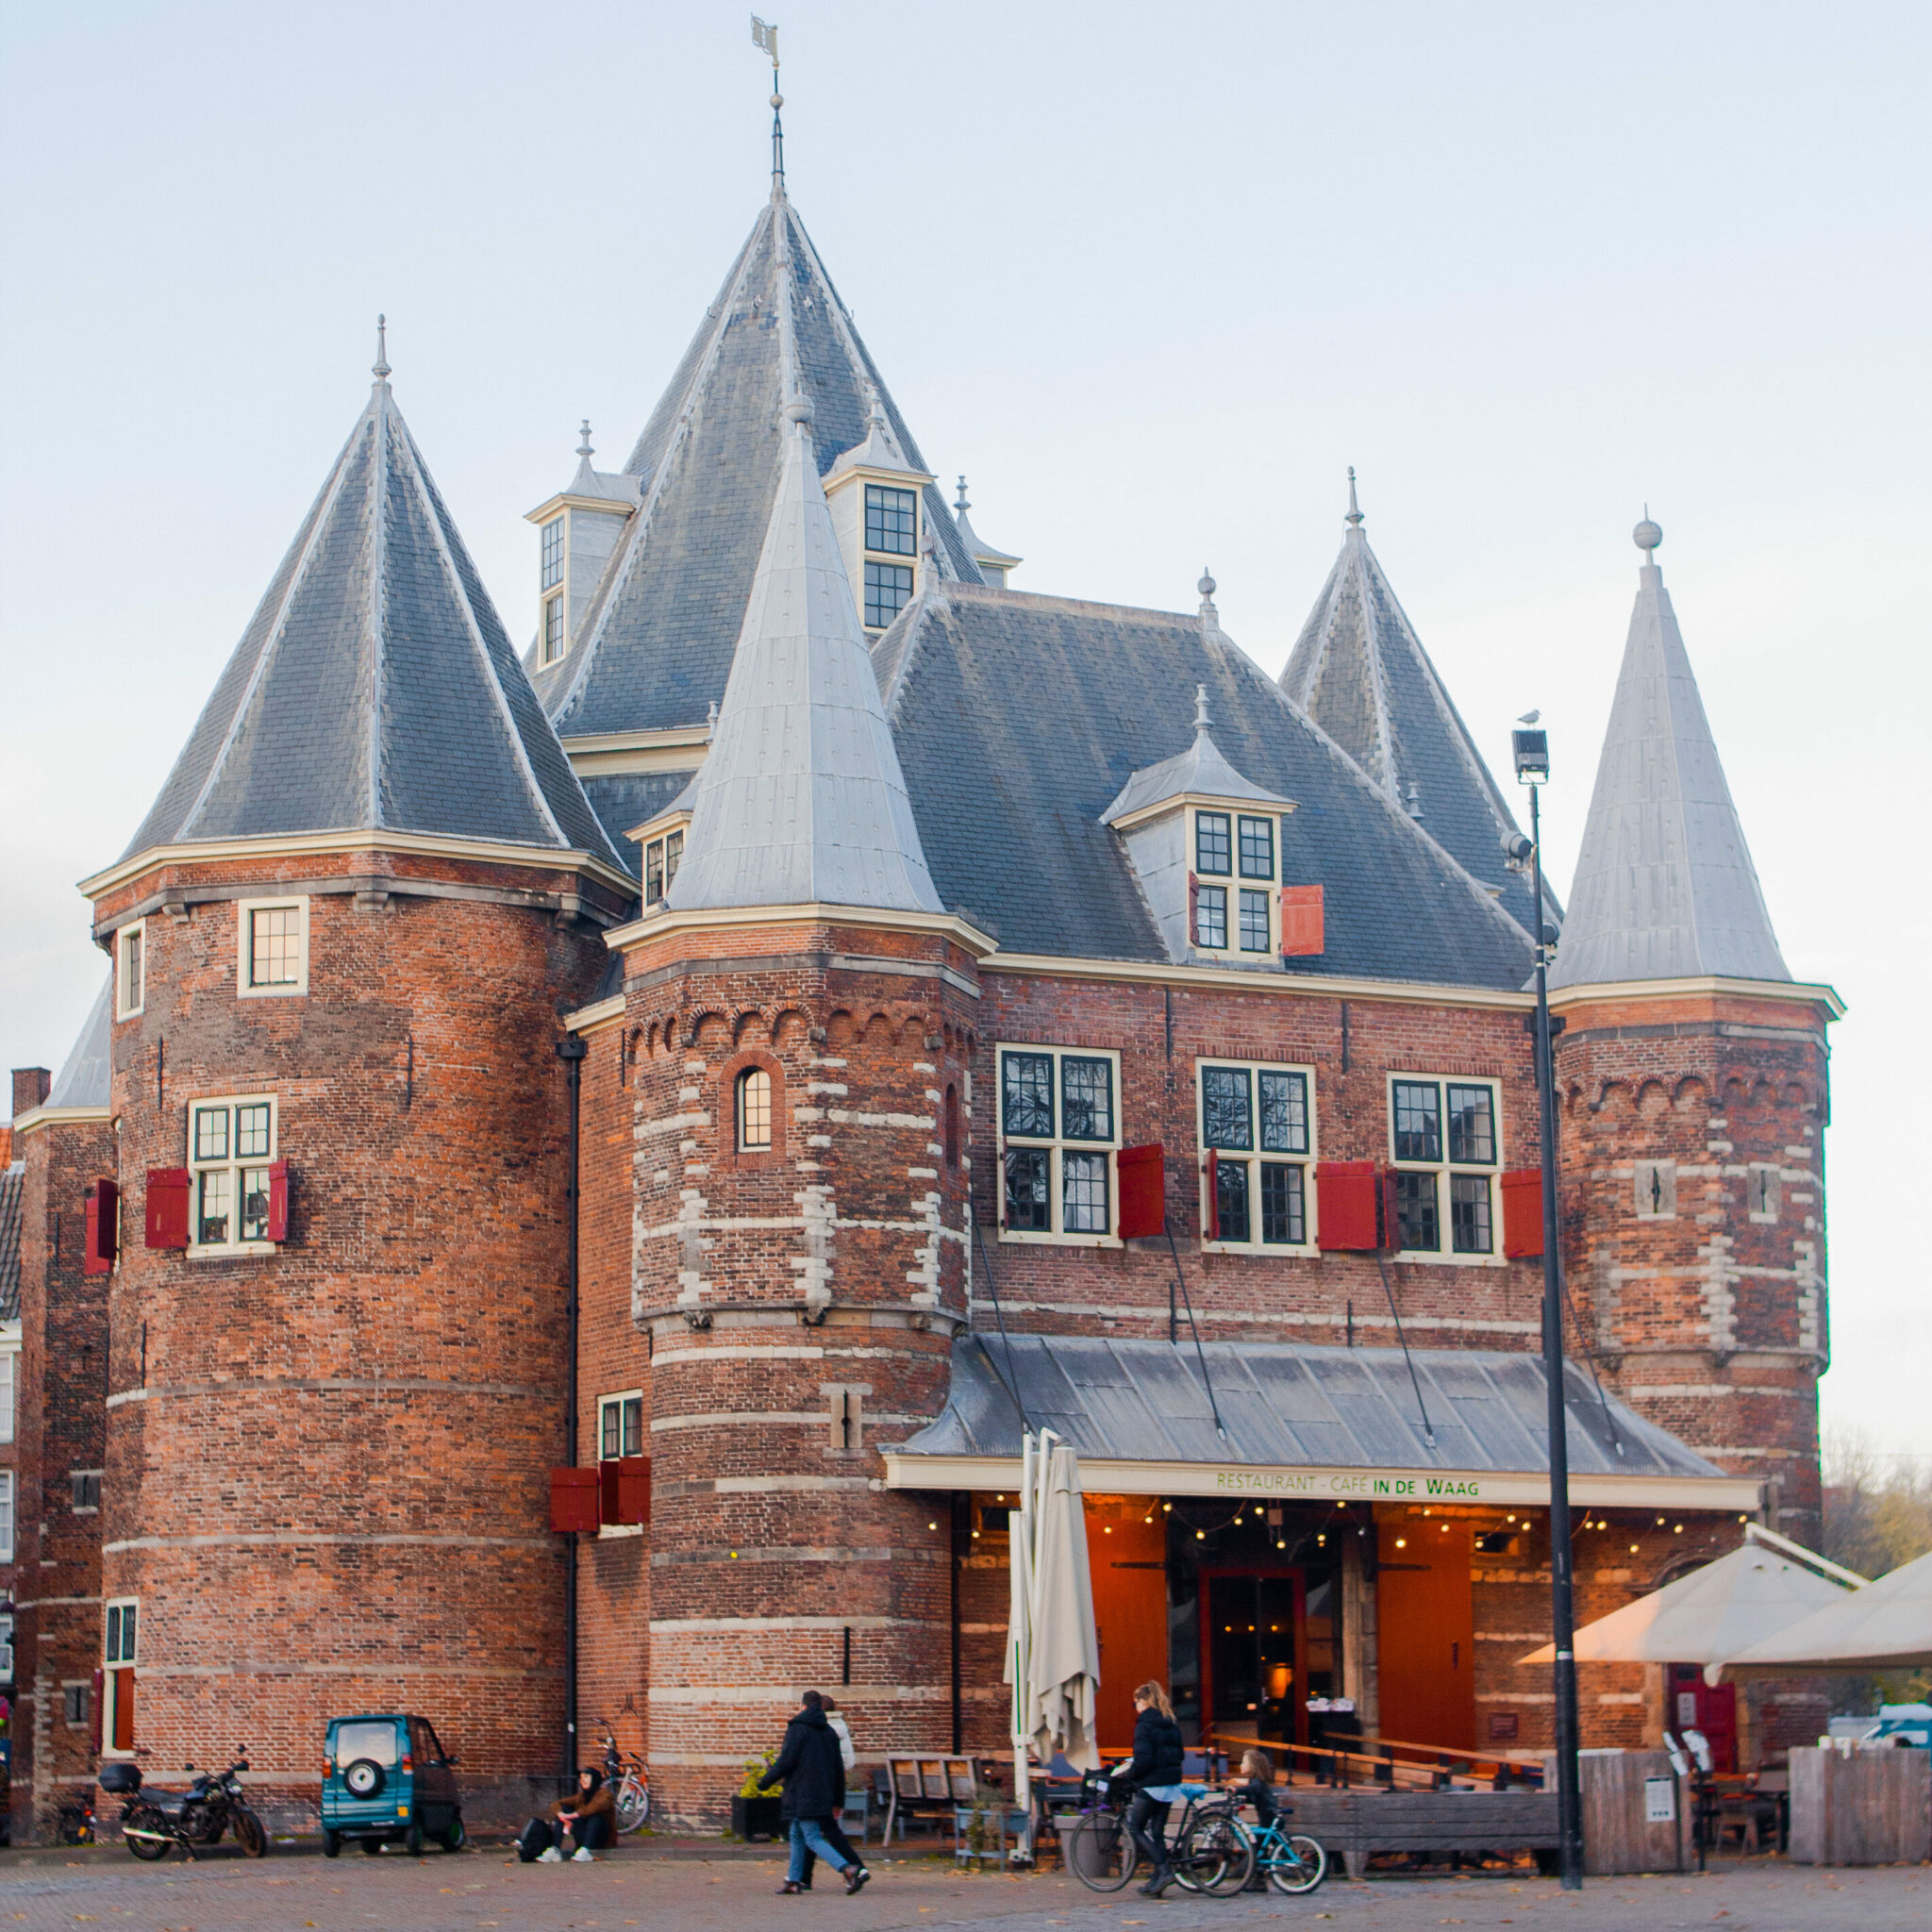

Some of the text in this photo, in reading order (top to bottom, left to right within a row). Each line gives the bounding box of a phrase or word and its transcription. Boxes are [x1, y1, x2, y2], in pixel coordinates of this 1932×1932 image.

[1217, 1473, 1316, 1491] RESTAURANT
[1330, 1475, 1367, 1491] CAFÉ
[1374, 1479, 1390, 1493] IN
[1396, 1480, 1416, 1494] DE
[1426, 1478, 1479, 1495] WAAG
